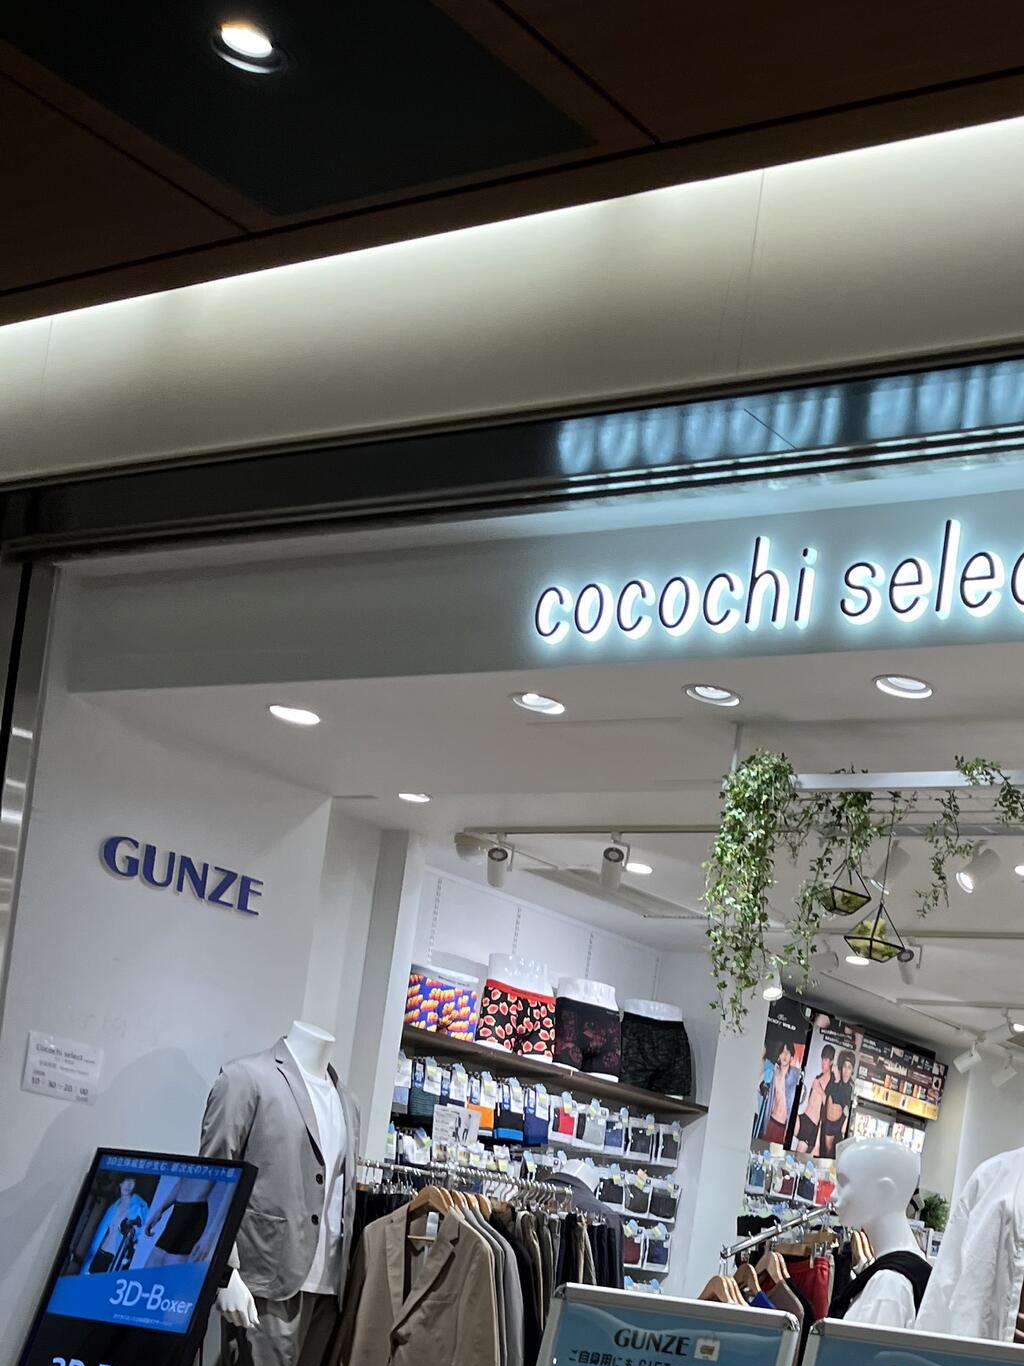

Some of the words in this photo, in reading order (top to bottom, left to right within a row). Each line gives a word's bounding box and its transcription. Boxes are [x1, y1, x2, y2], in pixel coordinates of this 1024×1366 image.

[534, 536, 815, 644] cocochi
[103, 836, 263, 915] GUNZE
[109, 1278, 193, 1314] 3D-Boxer
[614, 1328, 691, 1356] GUNZE
